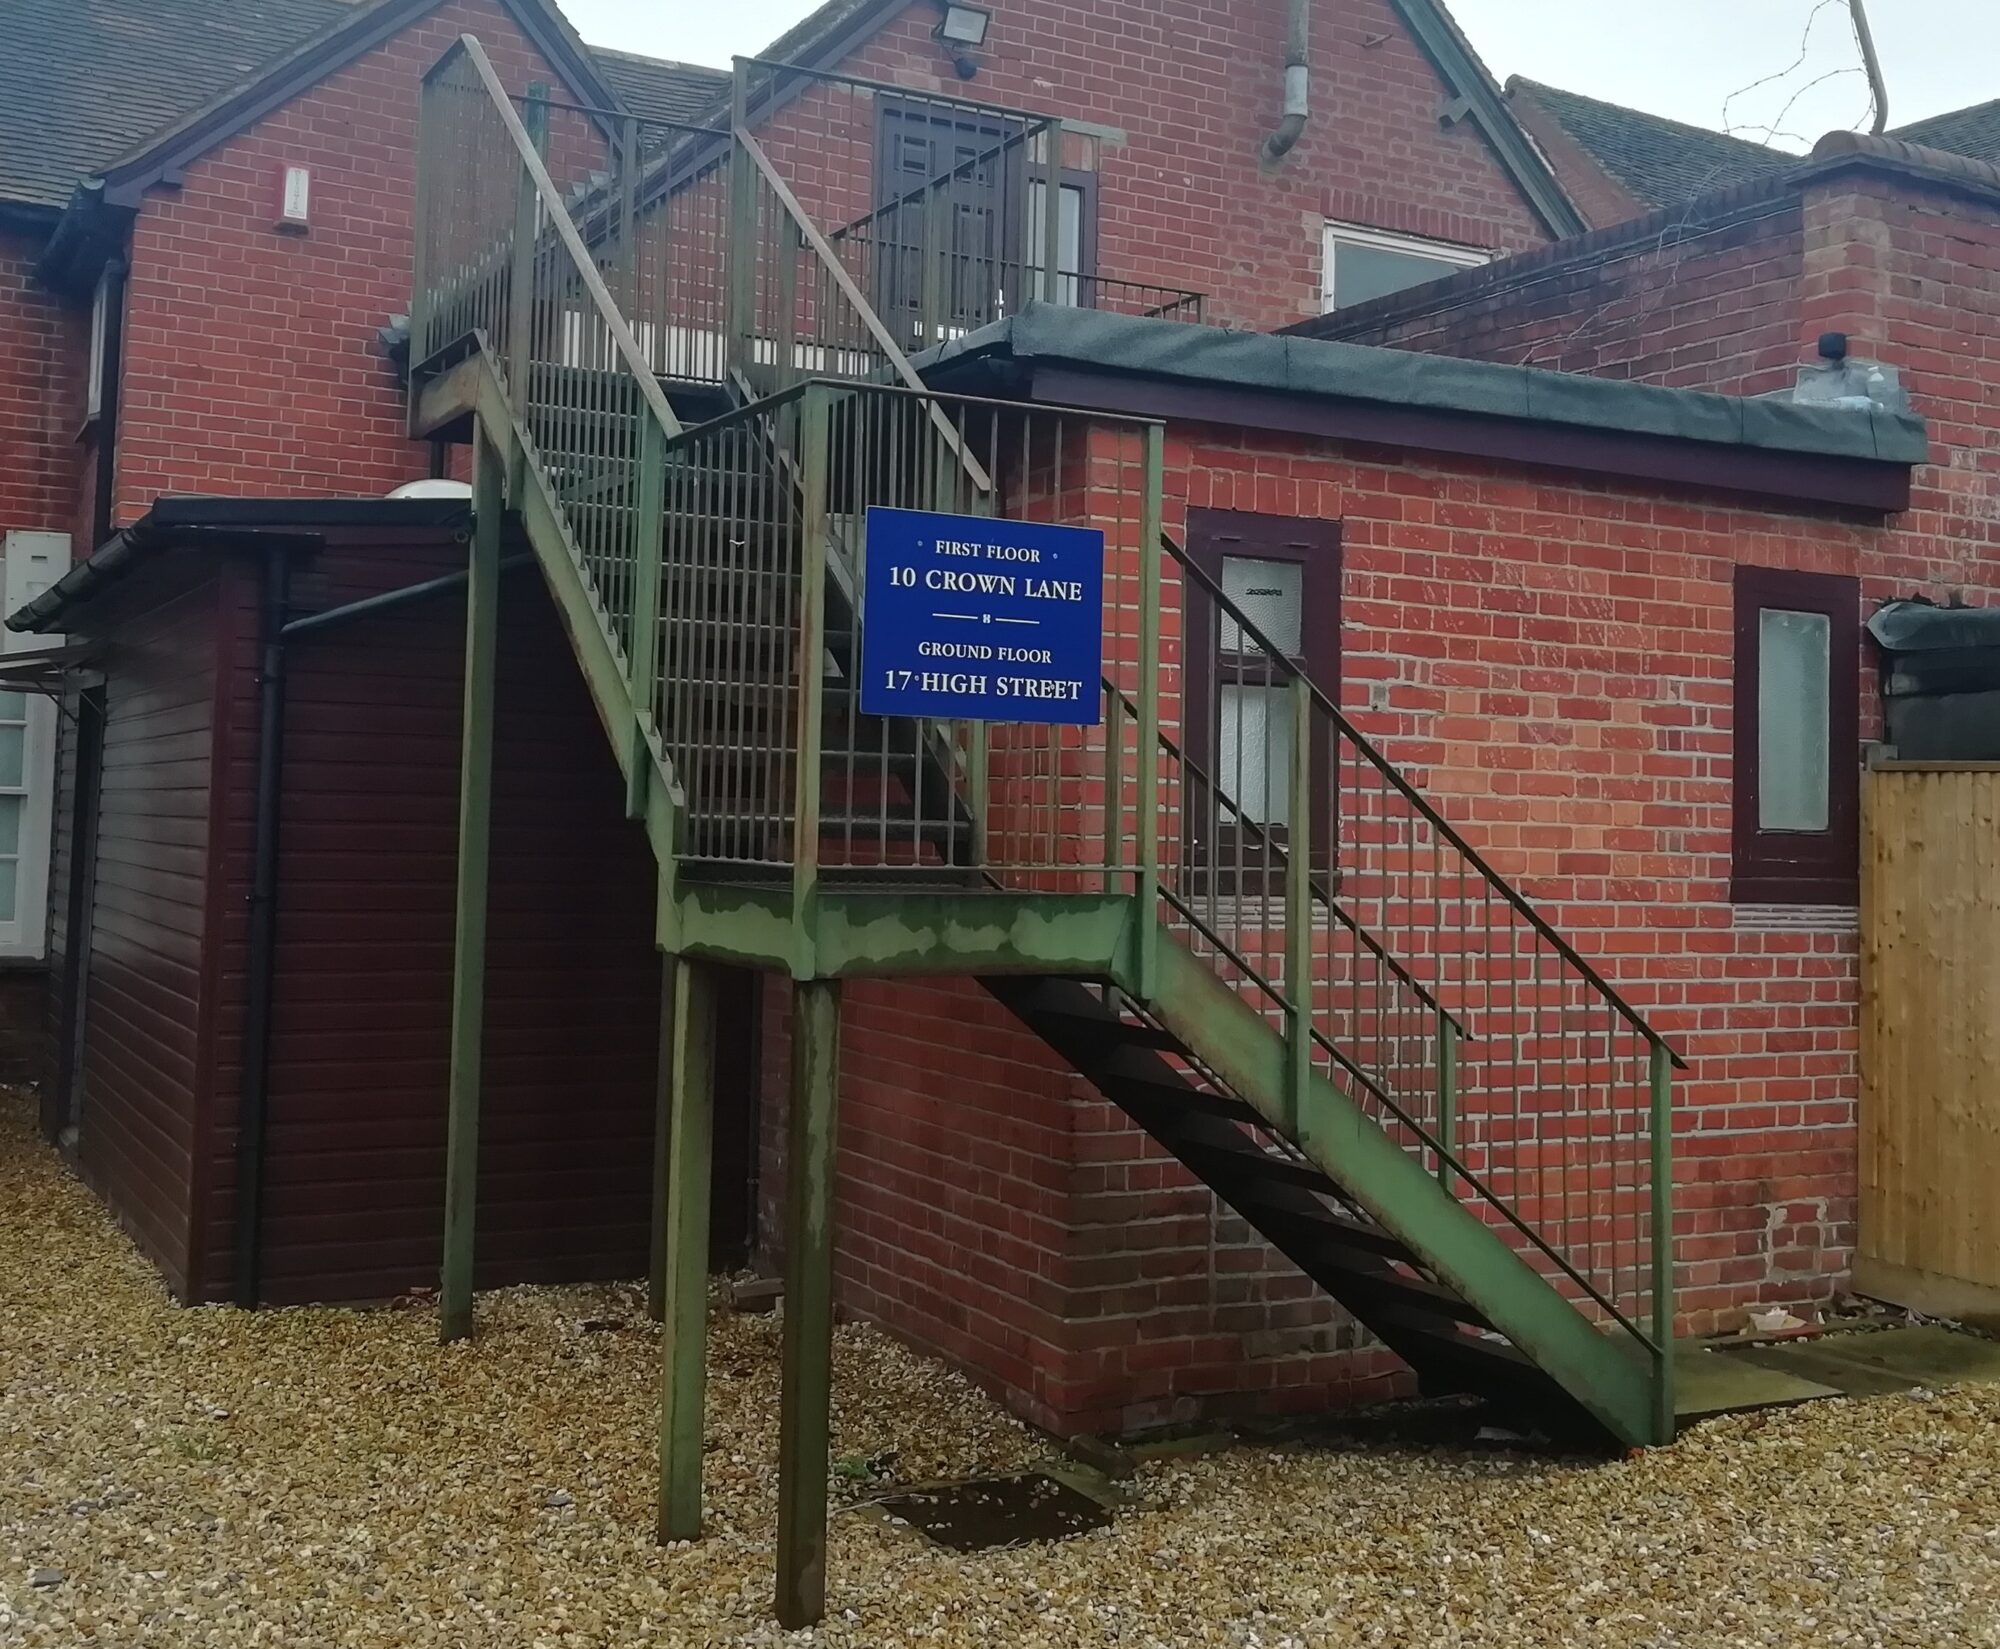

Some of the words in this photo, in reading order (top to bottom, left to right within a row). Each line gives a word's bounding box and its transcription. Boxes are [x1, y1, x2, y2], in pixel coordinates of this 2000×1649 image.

[935, 540, 982, 558] FIRST
[986, 545, 1041, 563] FLOOR
[889, 566, 916, 588] 10
[925, 569, 1015, 596] CROWN
[1024, 578, 1083, 601] LANE
[918, 641, 992, 660] GROUND
[997, 647, 1052, 664] FLOOR
[884, 670, 912, 691] 17
[920, 672, 988, 695] HIGH
[996, 676, 1083, 700] STREET
